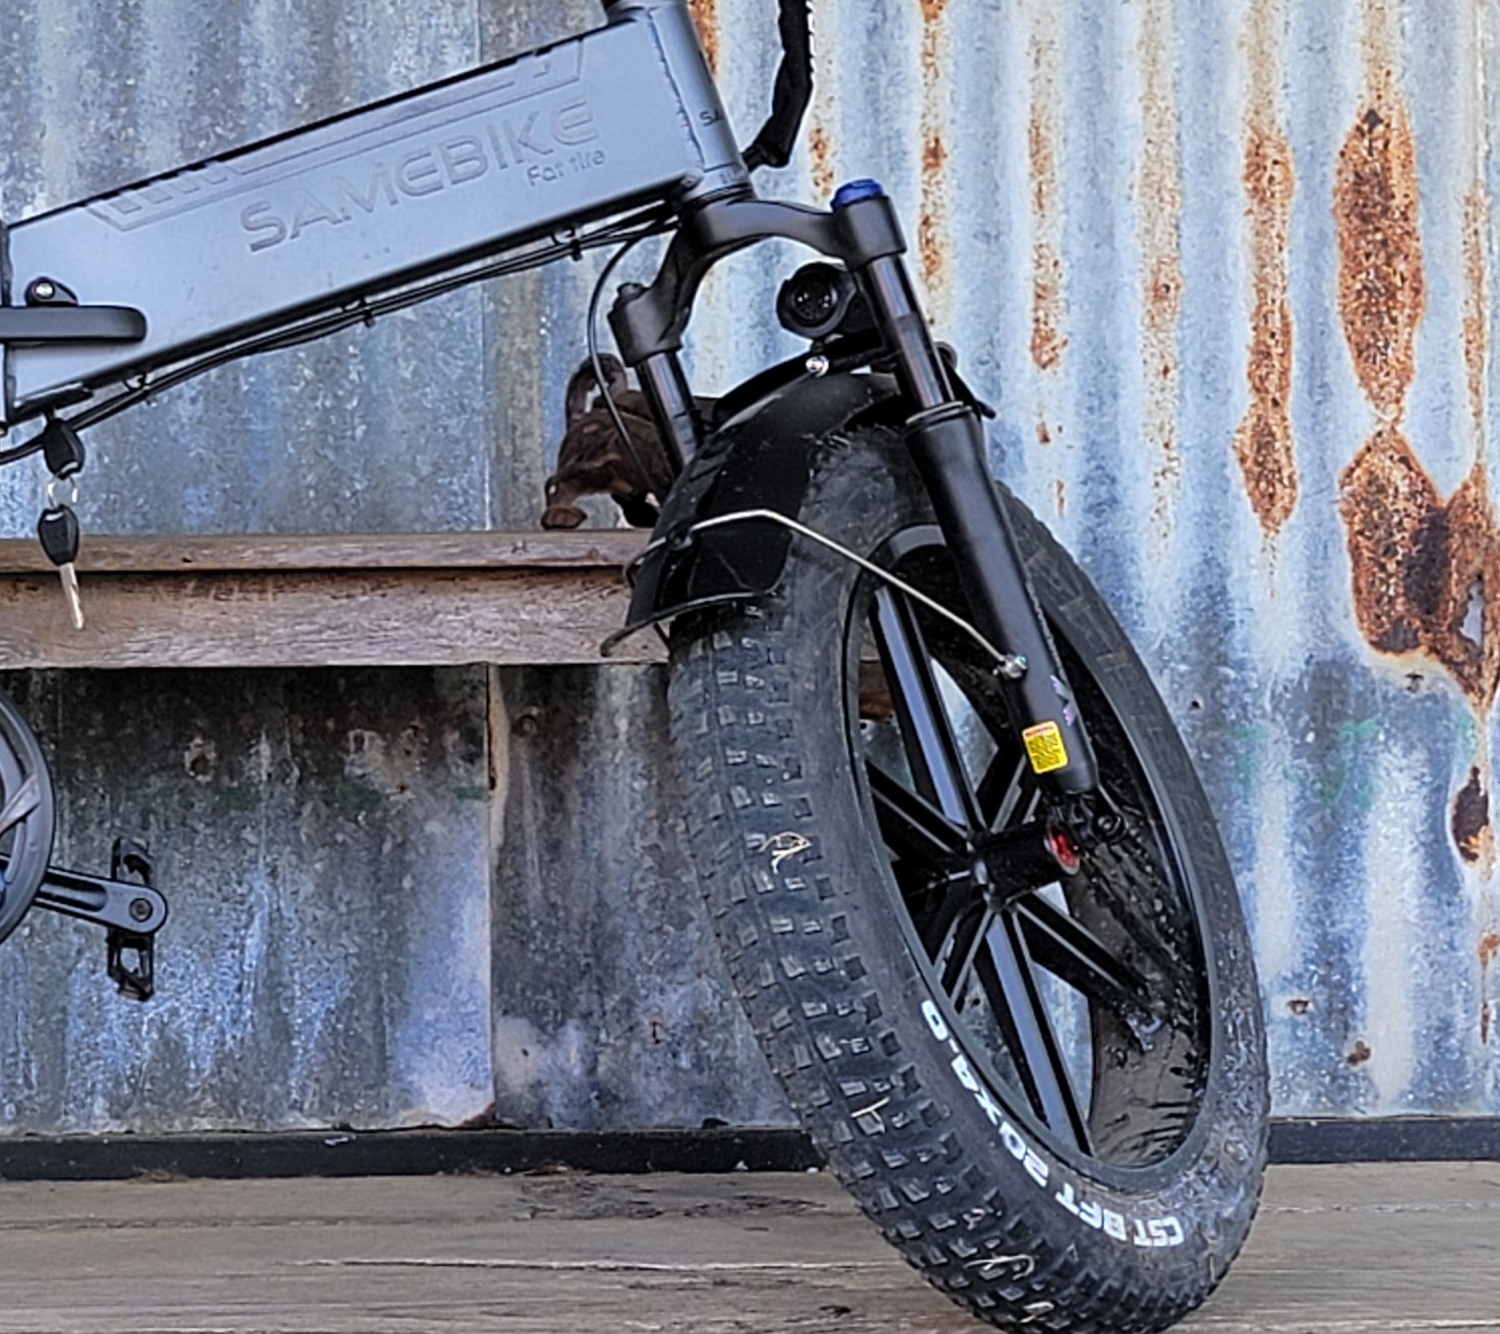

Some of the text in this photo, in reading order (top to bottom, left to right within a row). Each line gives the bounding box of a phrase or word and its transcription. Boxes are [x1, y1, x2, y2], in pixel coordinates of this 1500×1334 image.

[240, 100, 599, 252] SAMEBIKE
[527, 160, 565, 187] Fat
[1055, 1183, 1127, 1242] BFT
[1132, 1217, 1185, 1247] CST
